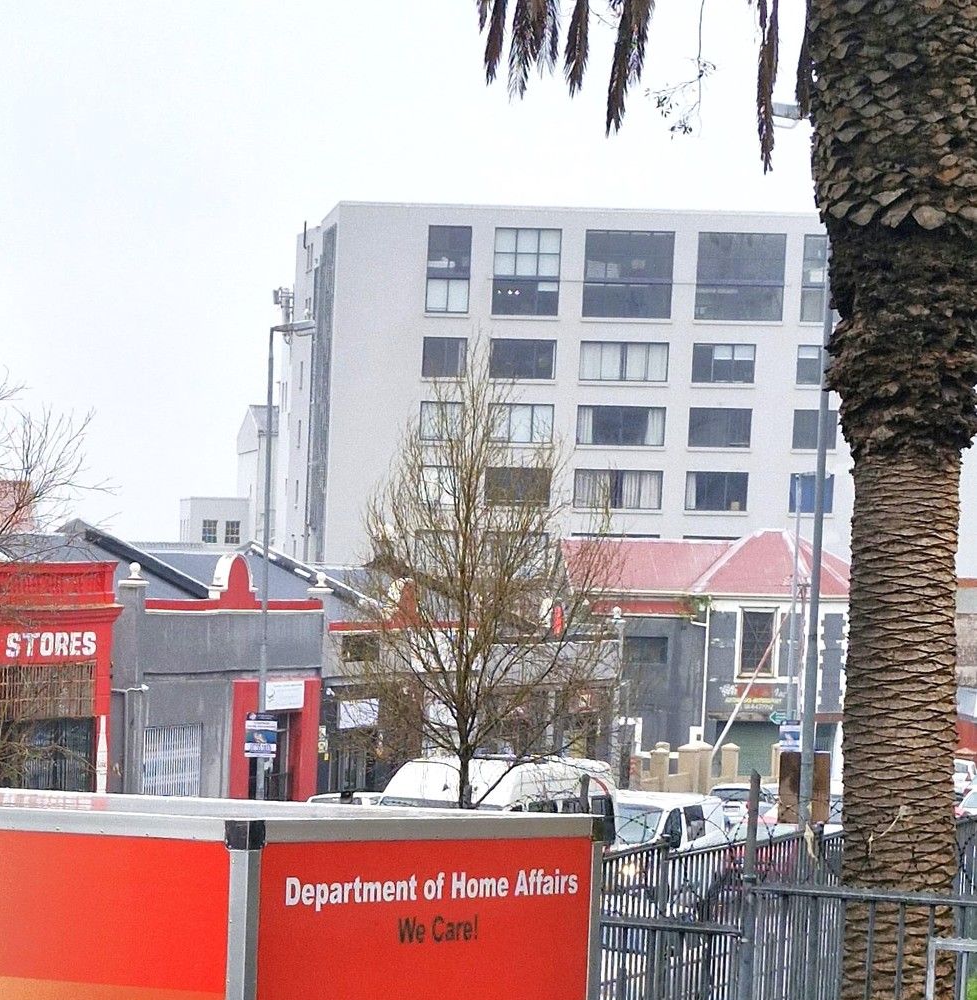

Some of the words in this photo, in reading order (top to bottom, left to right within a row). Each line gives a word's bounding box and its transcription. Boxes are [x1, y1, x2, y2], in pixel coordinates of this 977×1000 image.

[6, 630, 97, 658] STORES
[285, 873, 418, 912] Department
[424, 871, 446, 900] of
[451, 870, 510, 899] Home
[514, 868, 579, 897] Affairs
[398, 916, 426, 944] We
[431, 913, 480, 942] Care!
